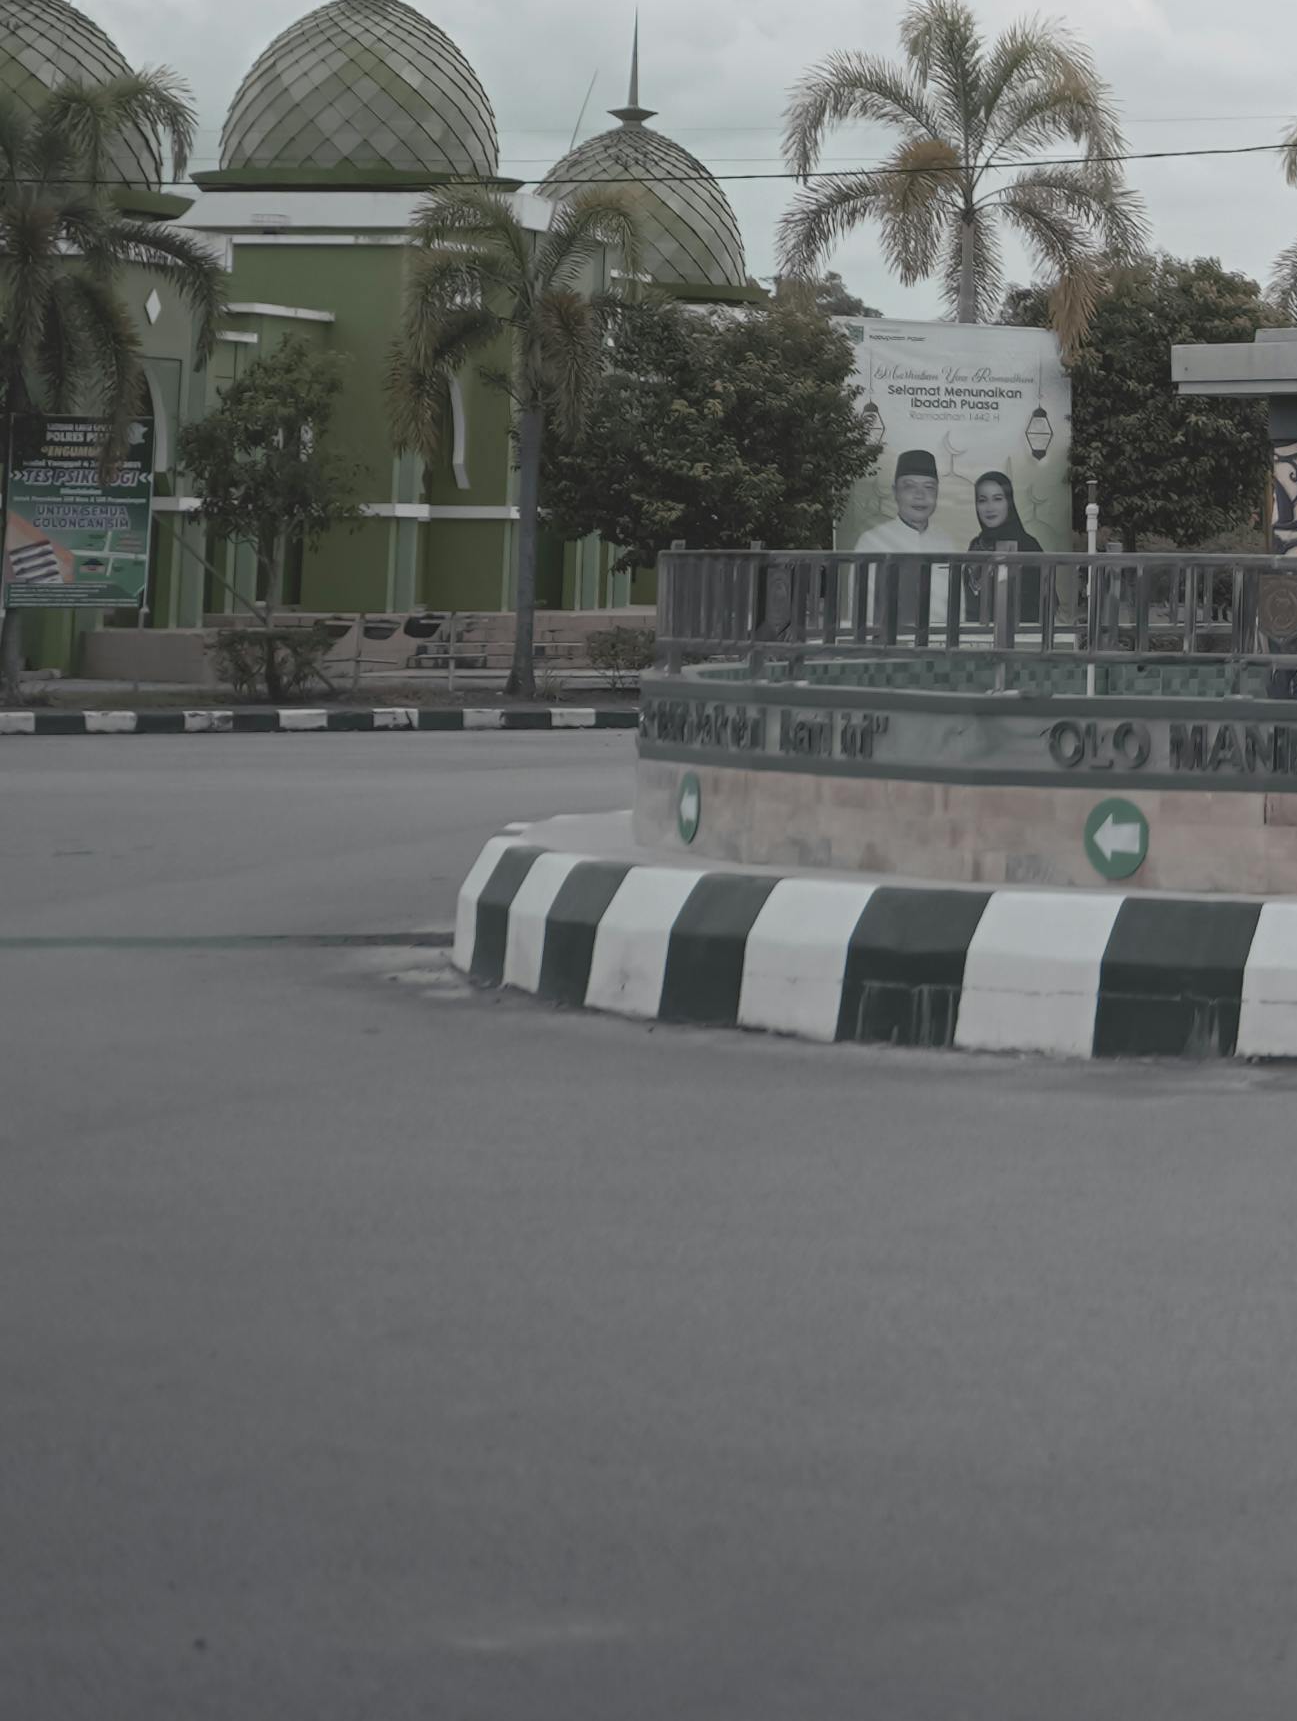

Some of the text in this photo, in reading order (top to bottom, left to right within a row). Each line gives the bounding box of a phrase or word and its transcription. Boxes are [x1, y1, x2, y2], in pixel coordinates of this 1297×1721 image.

[888, 384, 1022, 399] Selamat Menunaikan
[910, 398, 999, 410] Ibadah Puasa
[909, 411, 1000, 423] Ramadhan 1442 H
[46, 431, 84, 442] POLRES
[25, 468, 138, 487] TES PSIKOOGI
[37, 505, 128, 518] UNTUK SEMUA
[33, 517, 129, 528] GOLONGAN SIM
[1048, 720, 1152, 771] OLO
